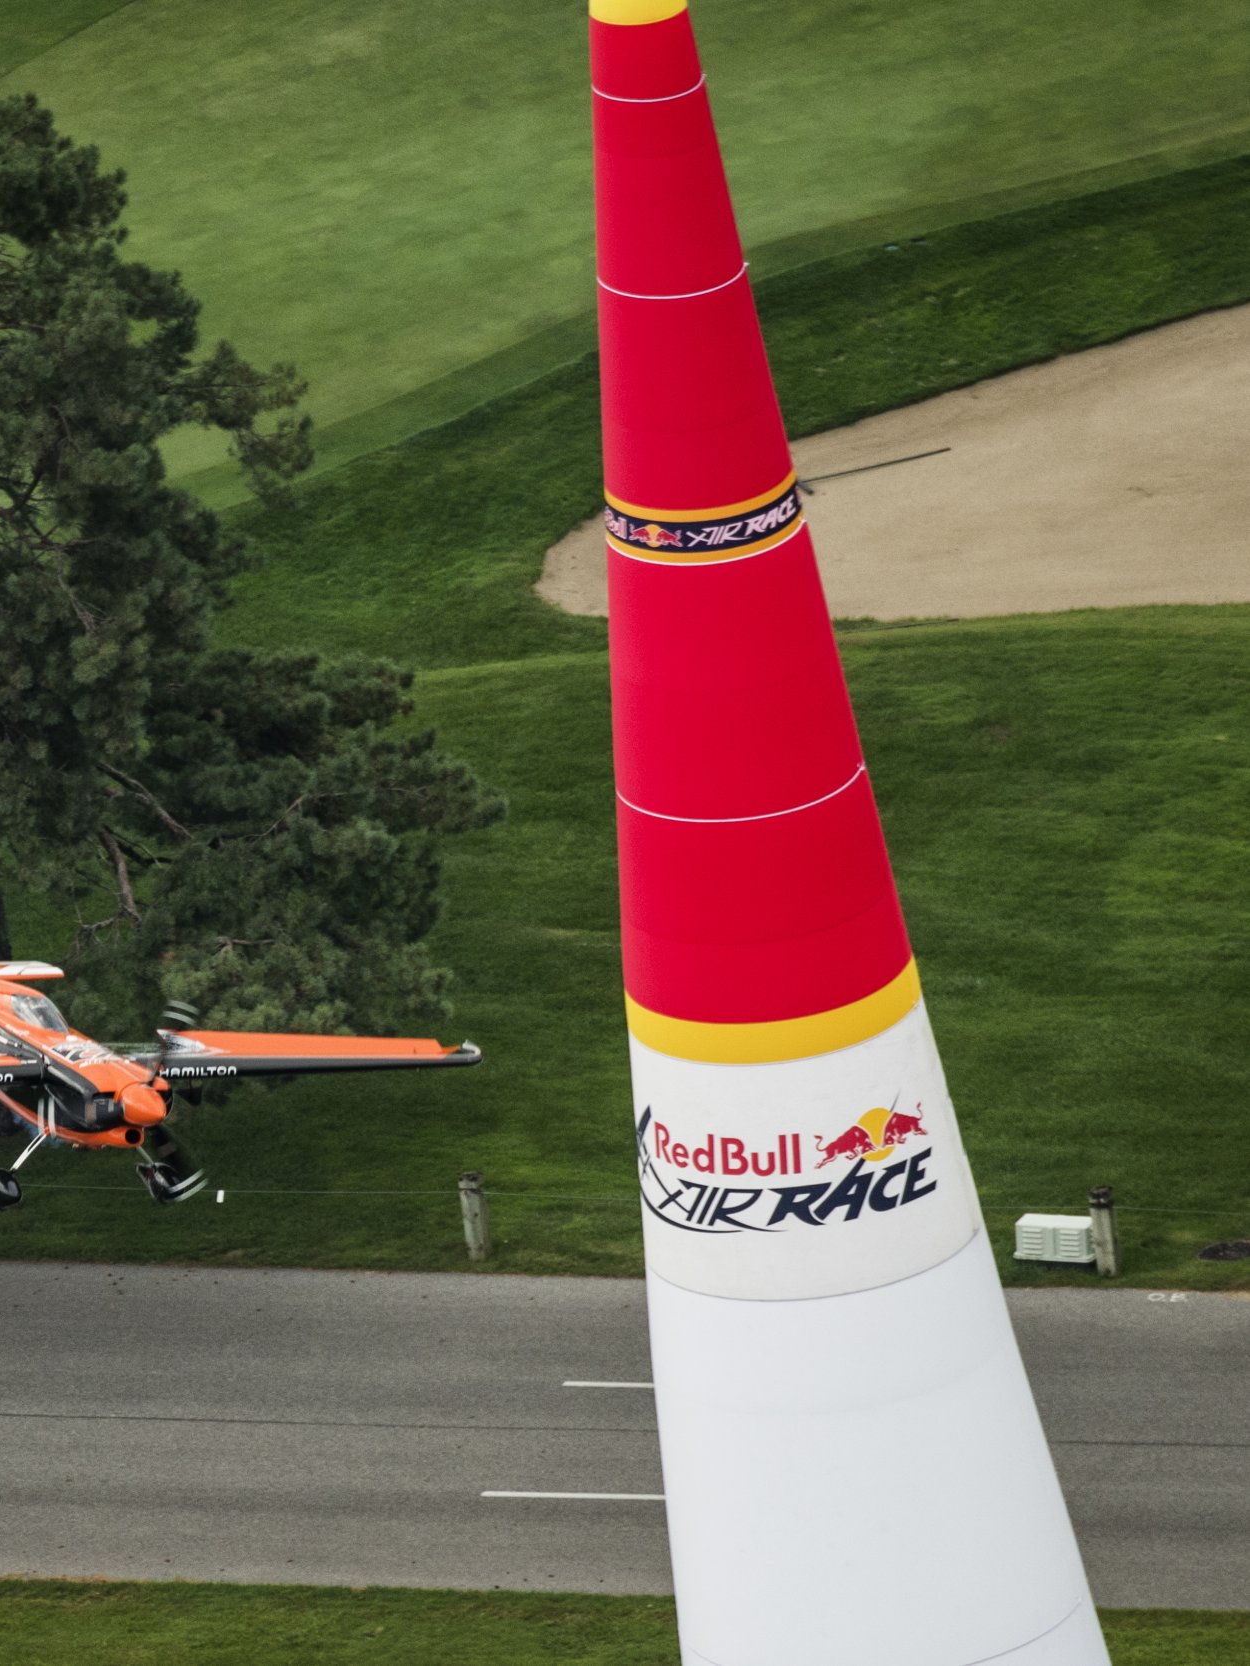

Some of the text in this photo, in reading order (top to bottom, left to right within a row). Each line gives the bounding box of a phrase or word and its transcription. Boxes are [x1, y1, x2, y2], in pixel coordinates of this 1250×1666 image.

[745, 495, 797, 536] RACE
[159, 1065, 237, 1077] HAMILTON
[765, 1146, 938, 1226] RACE
